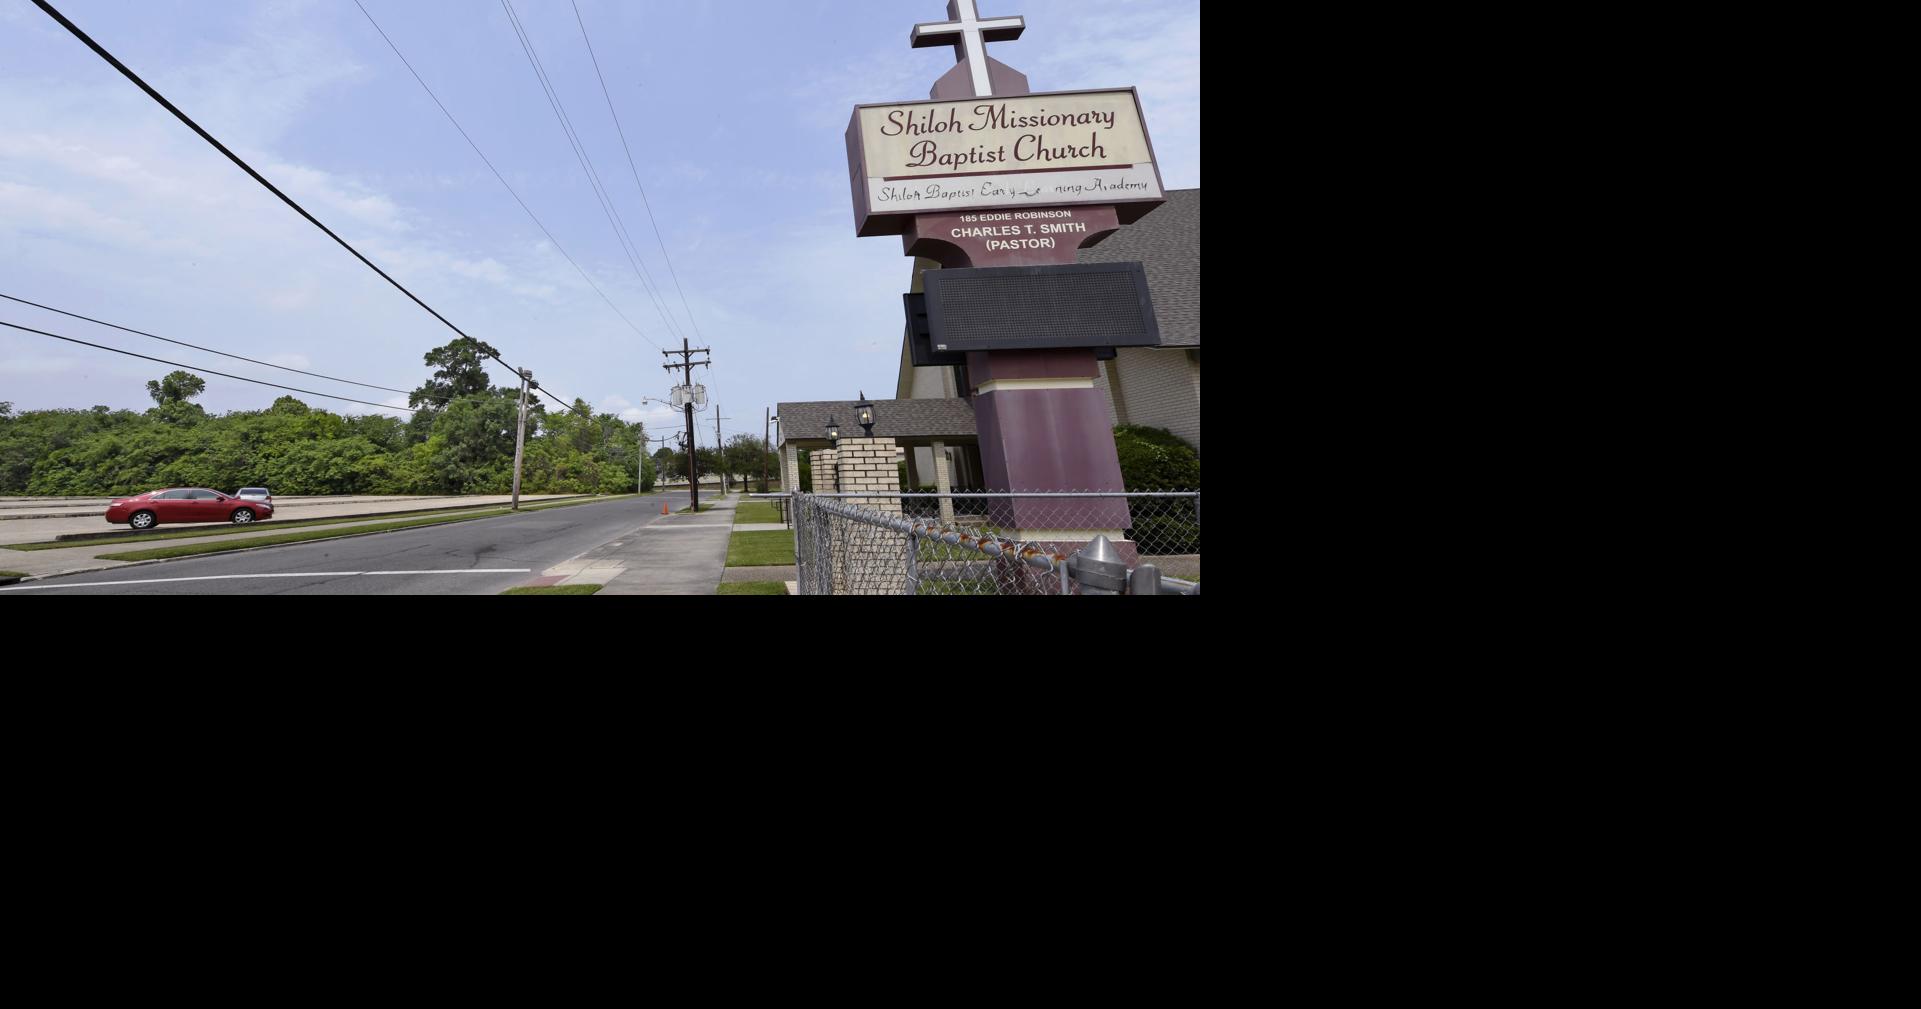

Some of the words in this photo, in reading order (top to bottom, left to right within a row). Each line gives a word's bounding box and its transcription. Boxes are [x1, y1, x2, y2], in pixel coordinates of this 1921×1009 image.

[880, 107, 964, 136] Shiloh
[968, 103, 1115, 130] Missionary
[905, 140, 1006, 171] Baptist
[1013, 131, 1107, 161] Church
[980, 181, 1015, 199] Eary
[1018, 182, 1082, 197] Lening
[1084, 177, 1147, 192] Aademy
[960, 214, 977, 223] 185
[980, 212, 1012, 222] EDDIE
[1014, 210, 1072, 220] ROBINSON
[951, 225, 1021, 238] CHARLES
[1024, 224, 1037, 235] T.
[1040, 222, 1087, 234] SMITH
[985, 236, 1056, 252] (PASTOR)
